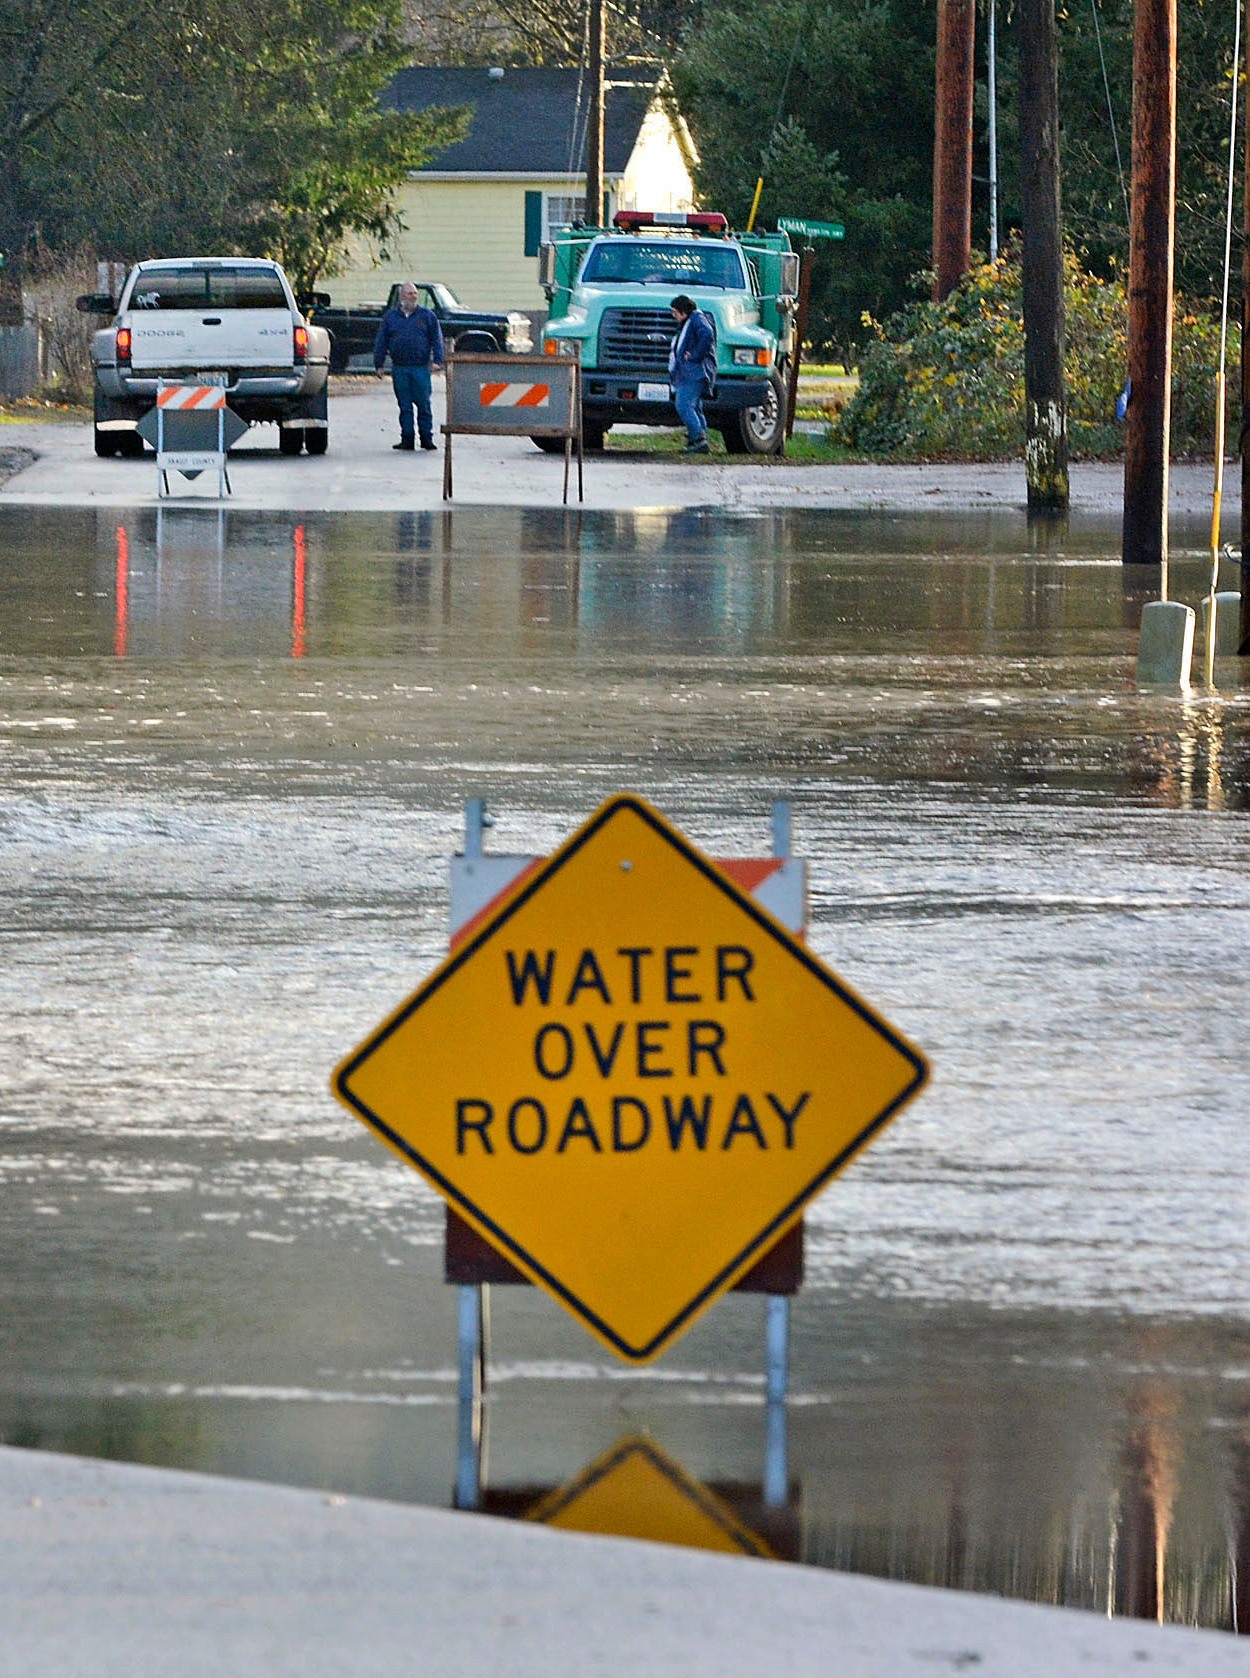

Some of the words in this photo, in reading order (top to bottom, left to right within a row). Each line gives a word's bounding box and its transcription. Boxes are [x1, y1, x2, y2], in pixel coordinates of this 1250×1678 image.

[137, 328, 185, 338] DODGE
[506, 945, 756, 1006] WATER
[534, 1020, 727, 1081] OVER
[455, 1092, 811, 1155] ROADWAY
